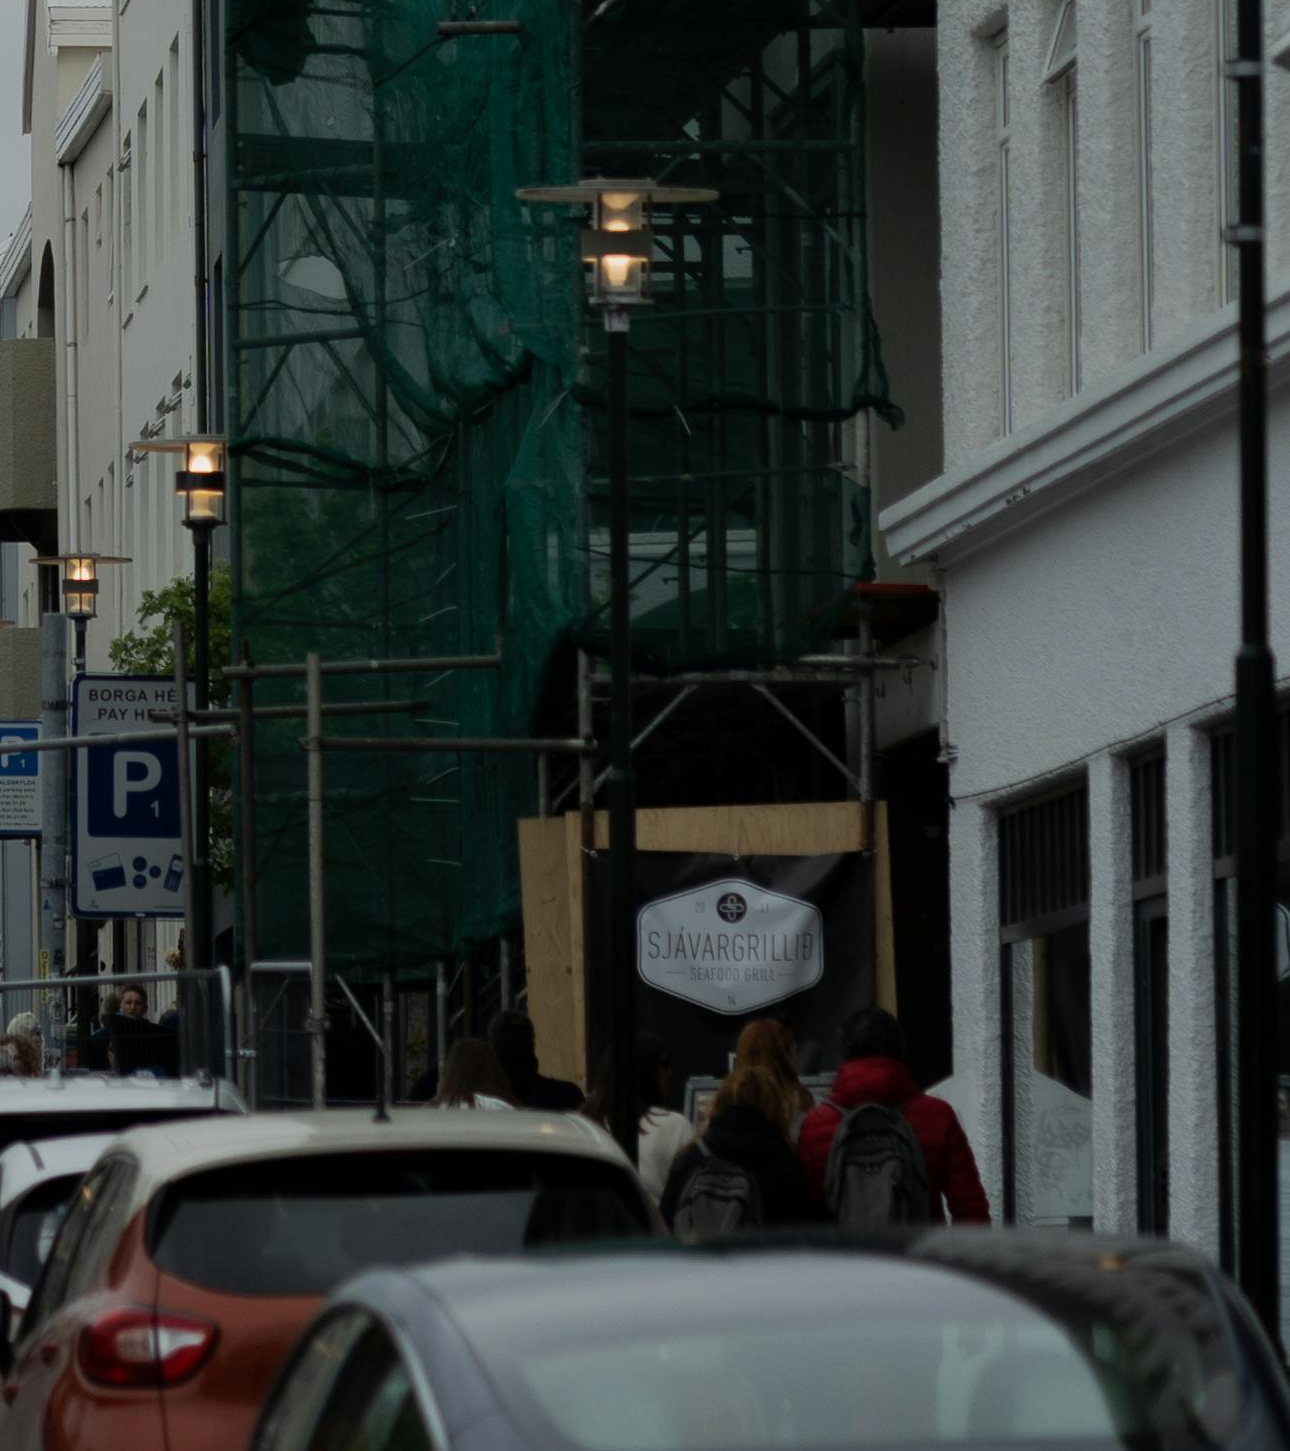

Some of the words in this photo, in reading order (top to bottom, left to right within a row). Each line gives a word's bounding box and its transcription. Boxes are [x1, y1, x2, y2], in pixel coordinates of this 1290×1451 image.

[89, 689, 148, 702] BORGA
[154, 687, 177, 703] HÉ
[98, 708, 128, 721] PAY
[113, 751, 162, 818] P
[150, 800, 159, 818] 1
[648, 926, 813, 962] SJÁVARGRILLIÐ
[690, 967, 740, 982] SEAFOOD
[744, 968, 776, 982] GRILL
